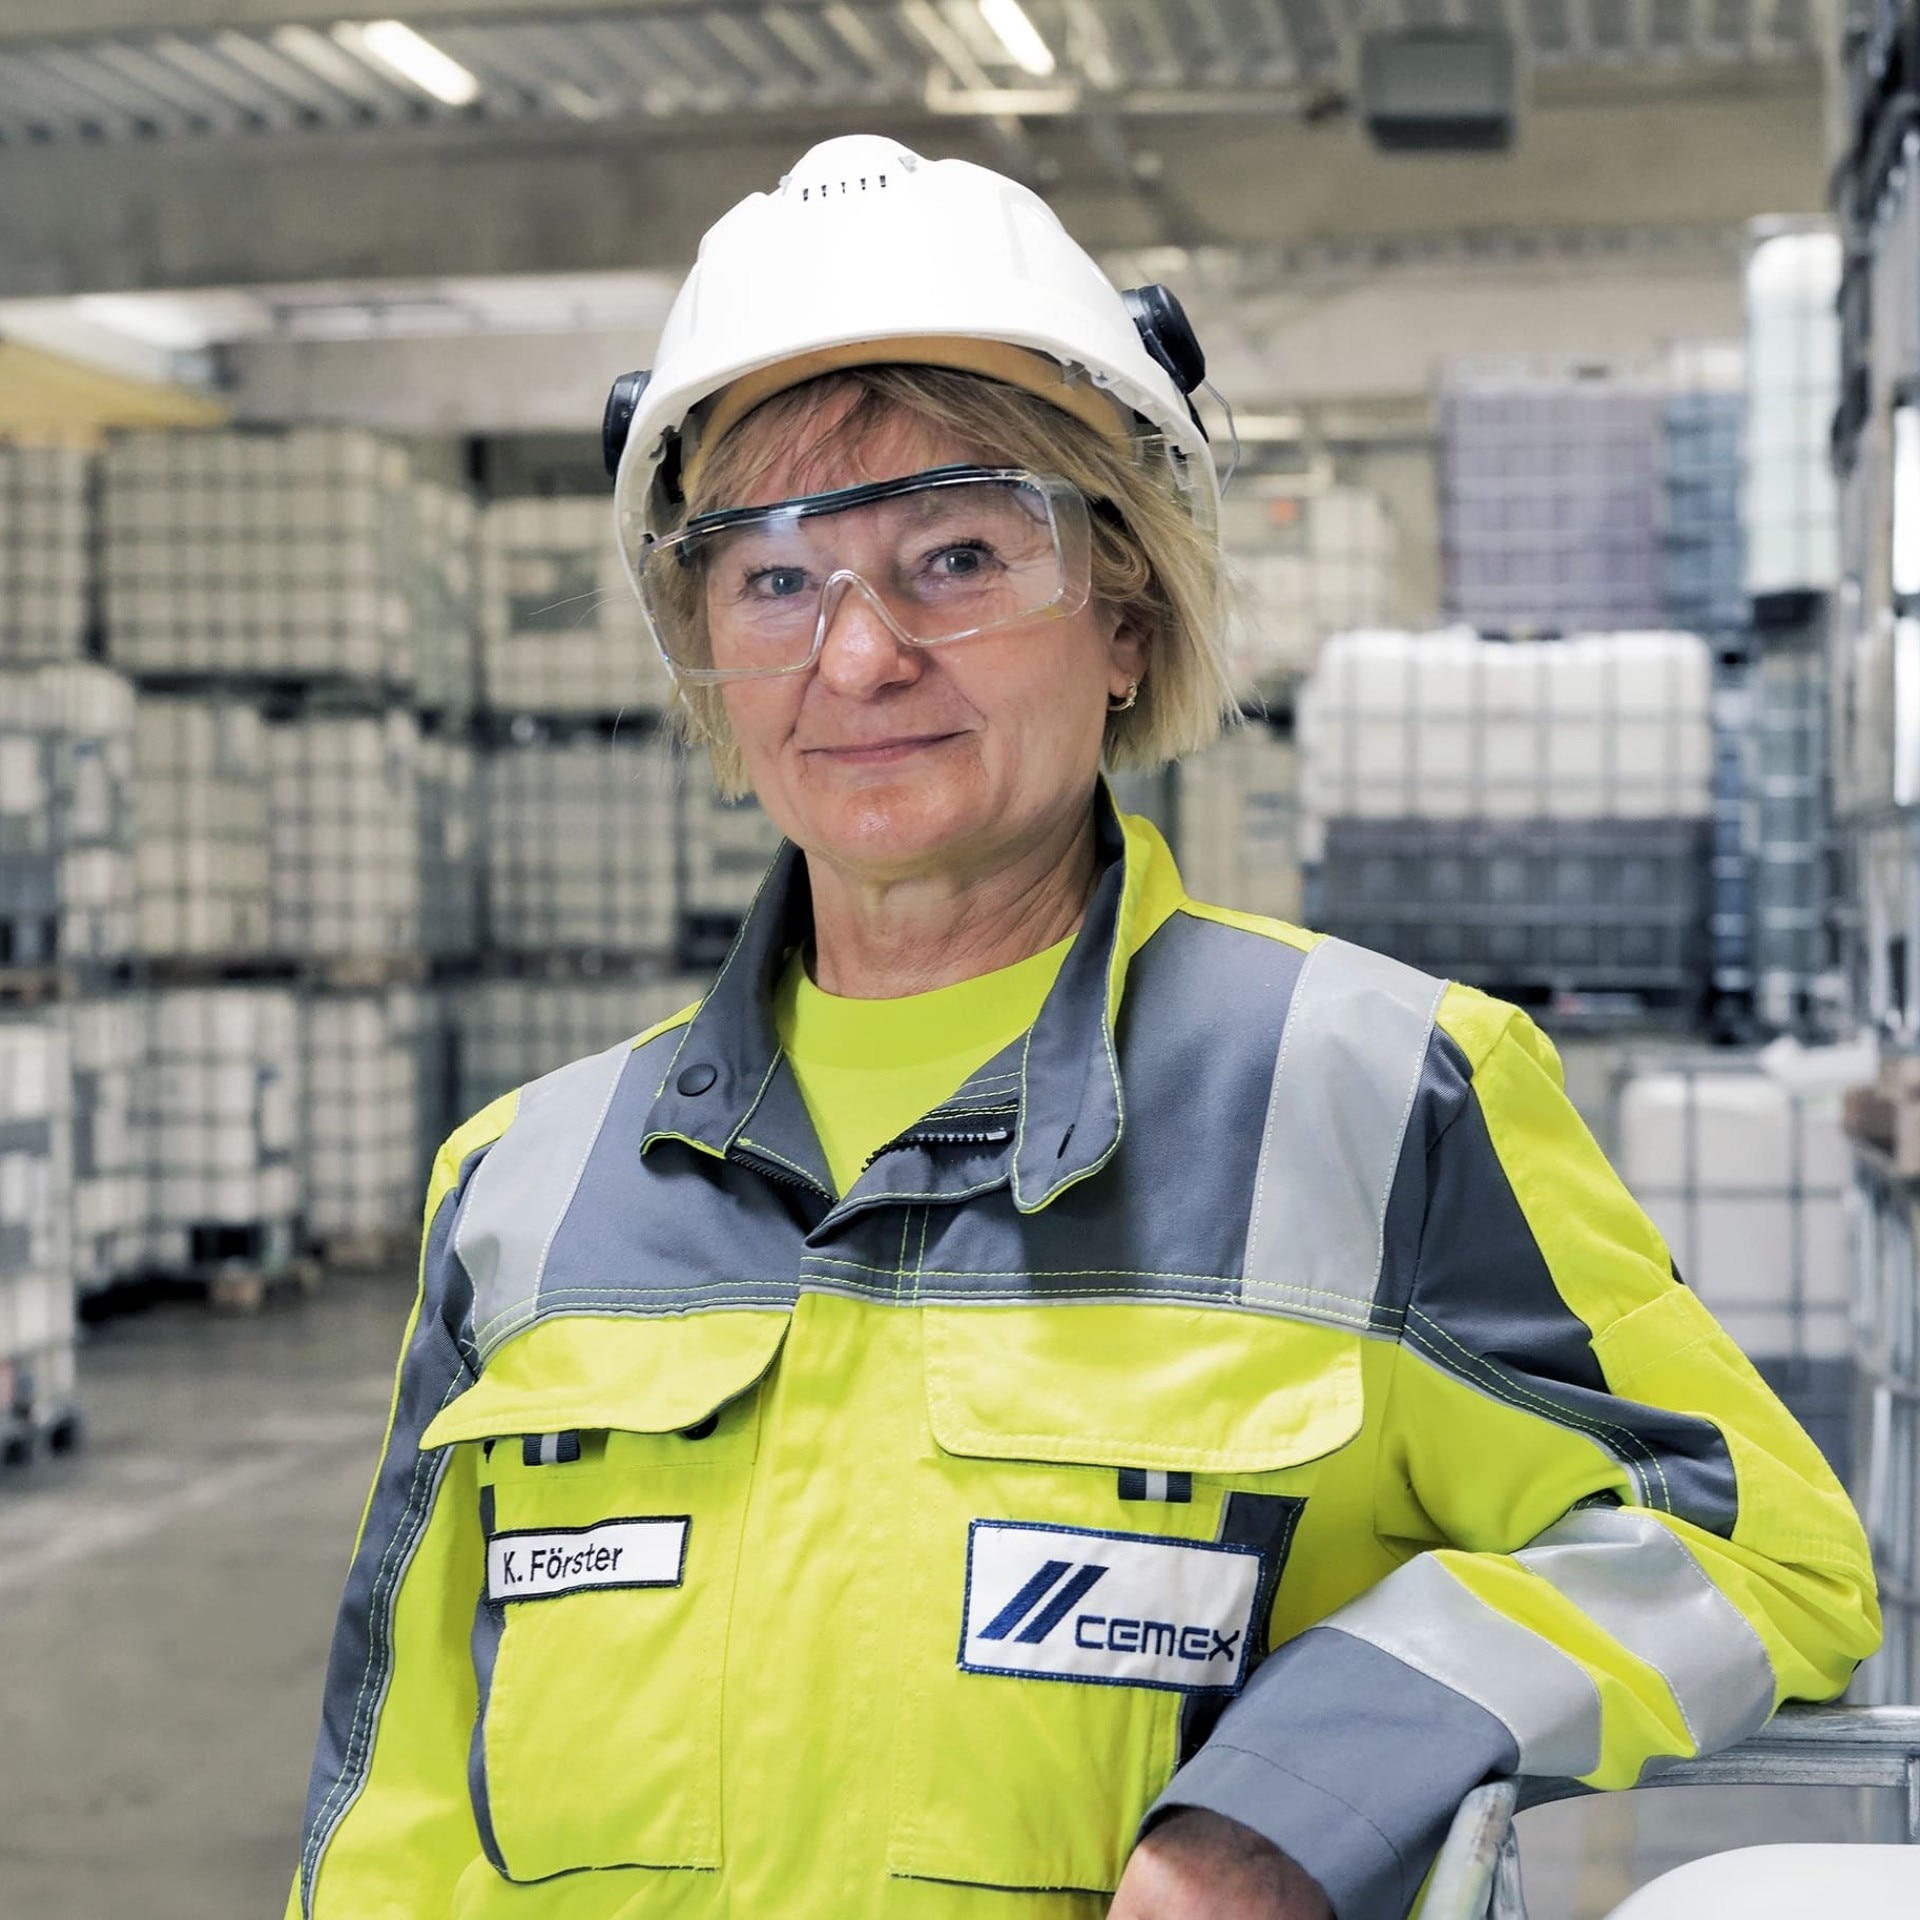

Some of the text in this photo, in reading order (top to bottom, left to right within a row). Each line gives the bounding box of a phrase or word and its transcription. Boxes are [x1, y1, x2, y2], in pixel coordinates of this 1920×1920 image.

[503, 1543, 623, 1585] K. Förster
[1074, 1614, 1241, 1662] CEMEX
